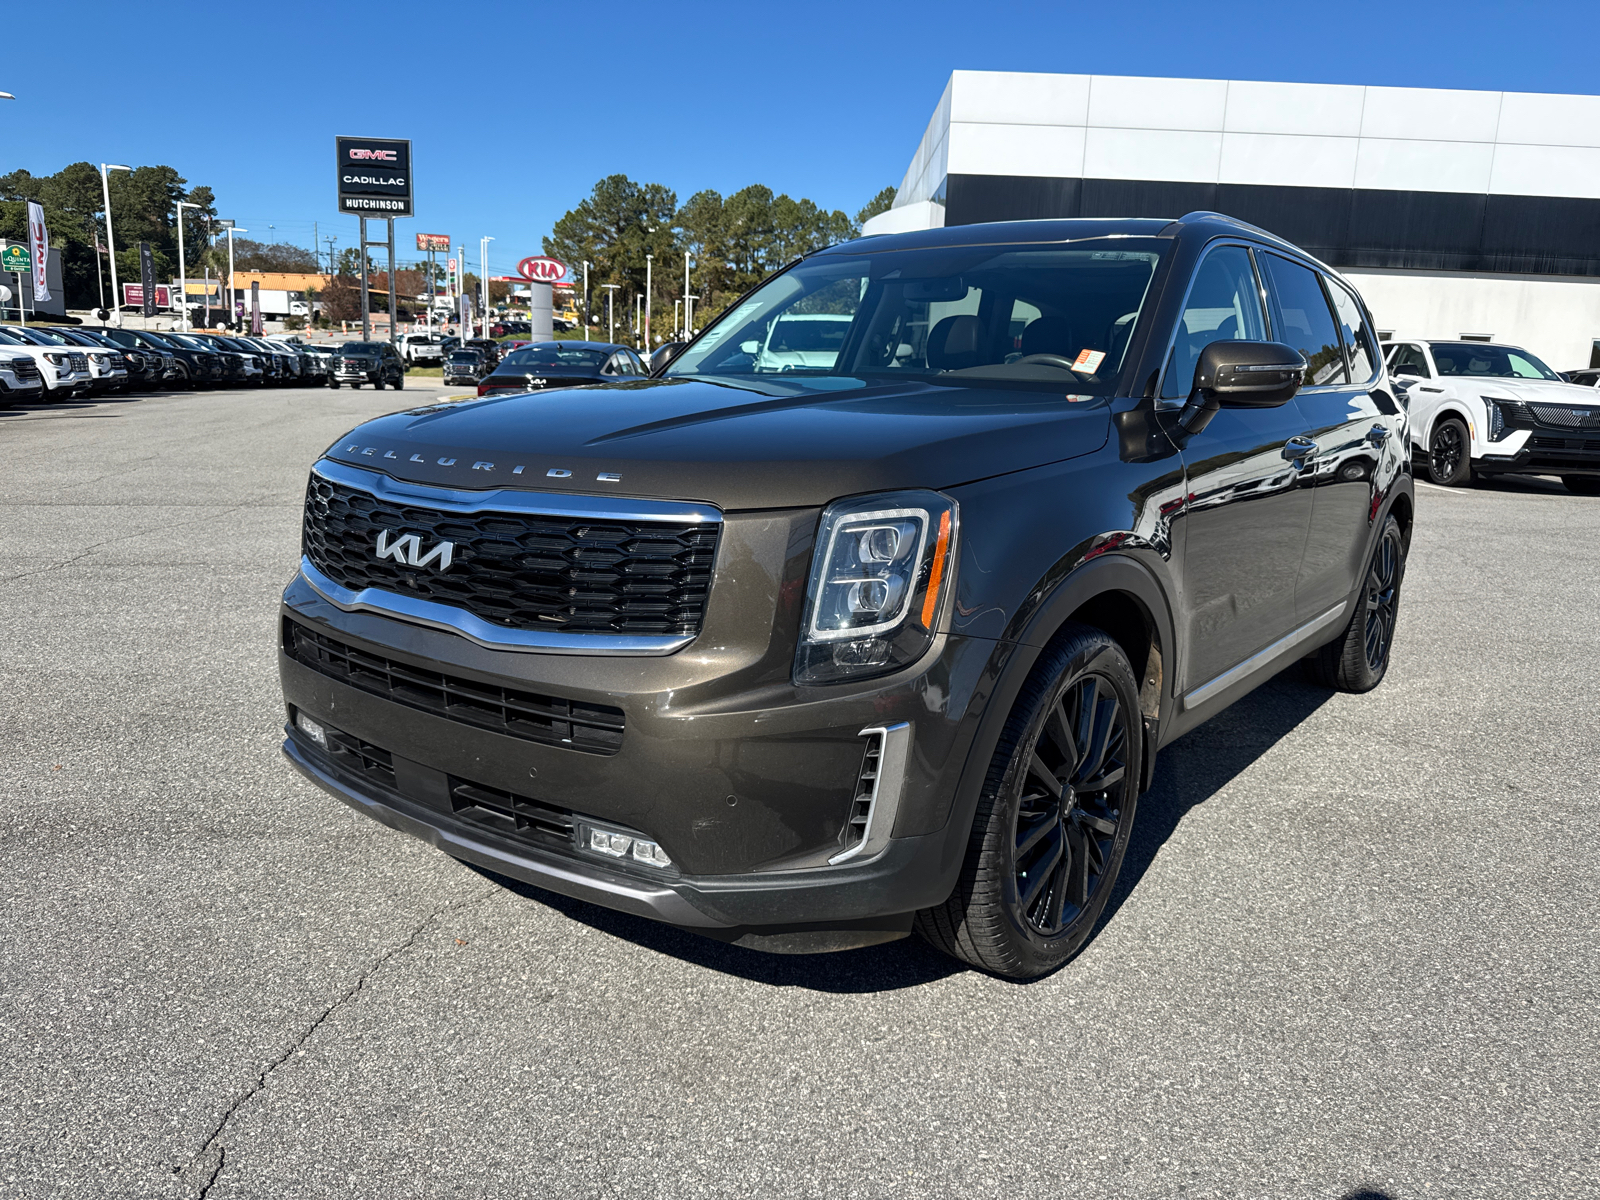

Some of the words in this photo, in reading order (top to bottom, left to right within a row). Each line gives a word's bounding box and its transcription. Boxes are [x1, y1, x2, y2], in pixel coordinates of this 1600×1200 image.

[350, 149, 397, 160] GMC
[343, 175, 405, 186] CADILLAC
[346, 199, 405, 210] HUTCHINSON
[527, 260, 560, 279] KIA
[345, 444, 624, 483] TELLURIDE
[376, 529, 454, 572] KIA
